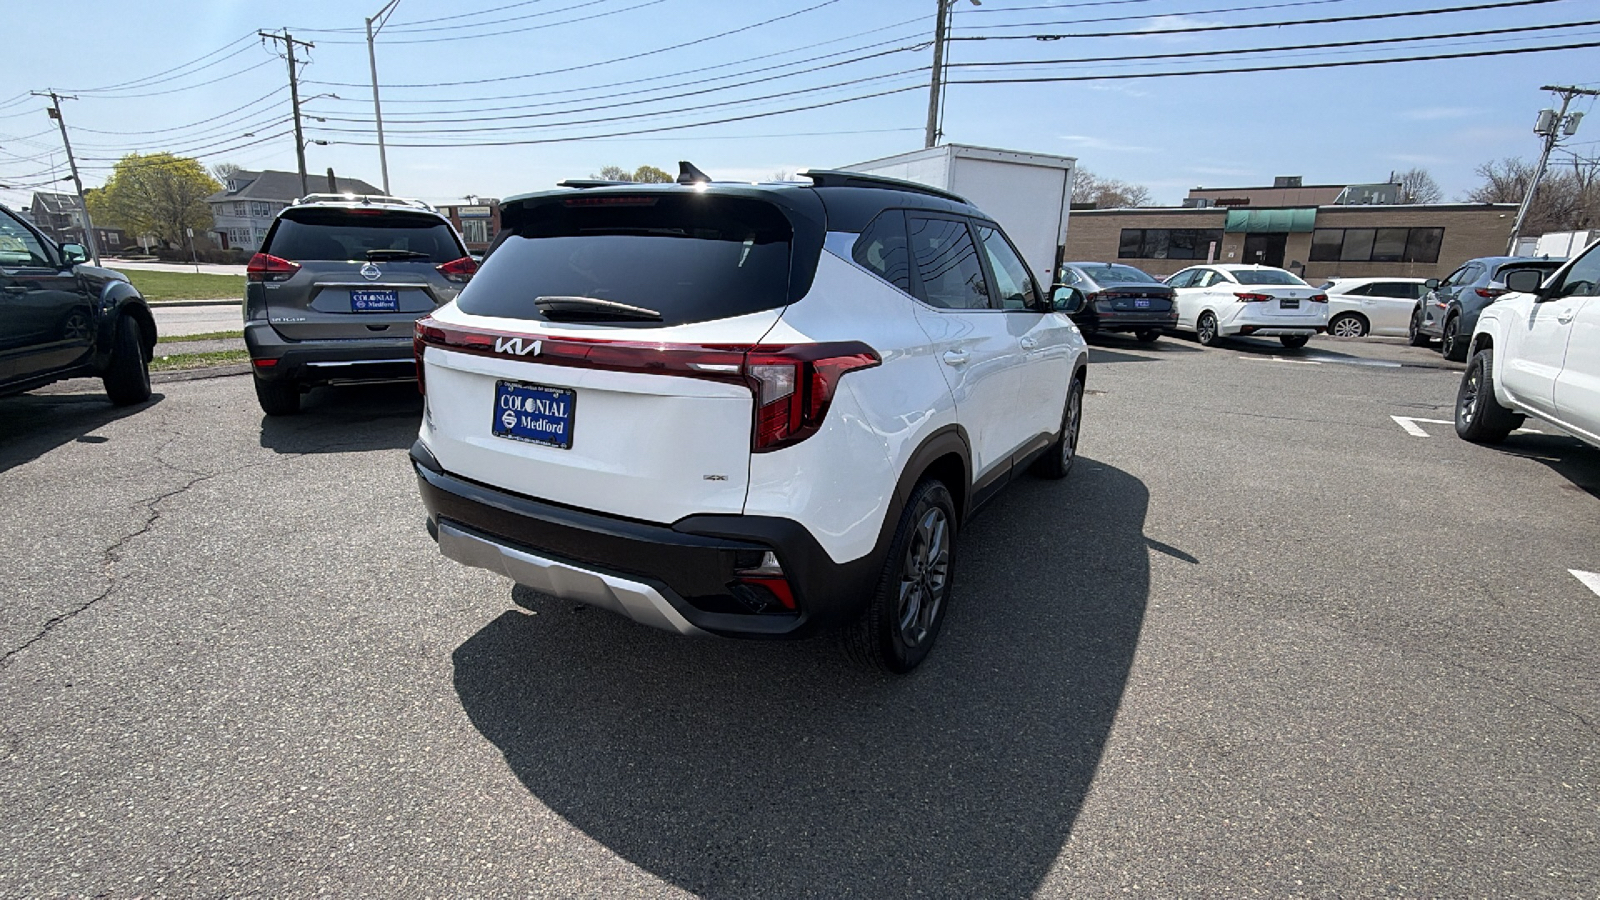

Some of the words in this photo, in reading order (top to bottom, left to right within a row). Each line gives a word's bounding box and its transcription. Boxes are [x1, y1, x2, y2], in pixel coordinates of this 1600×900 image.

[494, 336, 542, 356] KIA
[500, 394, 568, 418] COLONIAL
[521, 416, 564, 434] Medford
